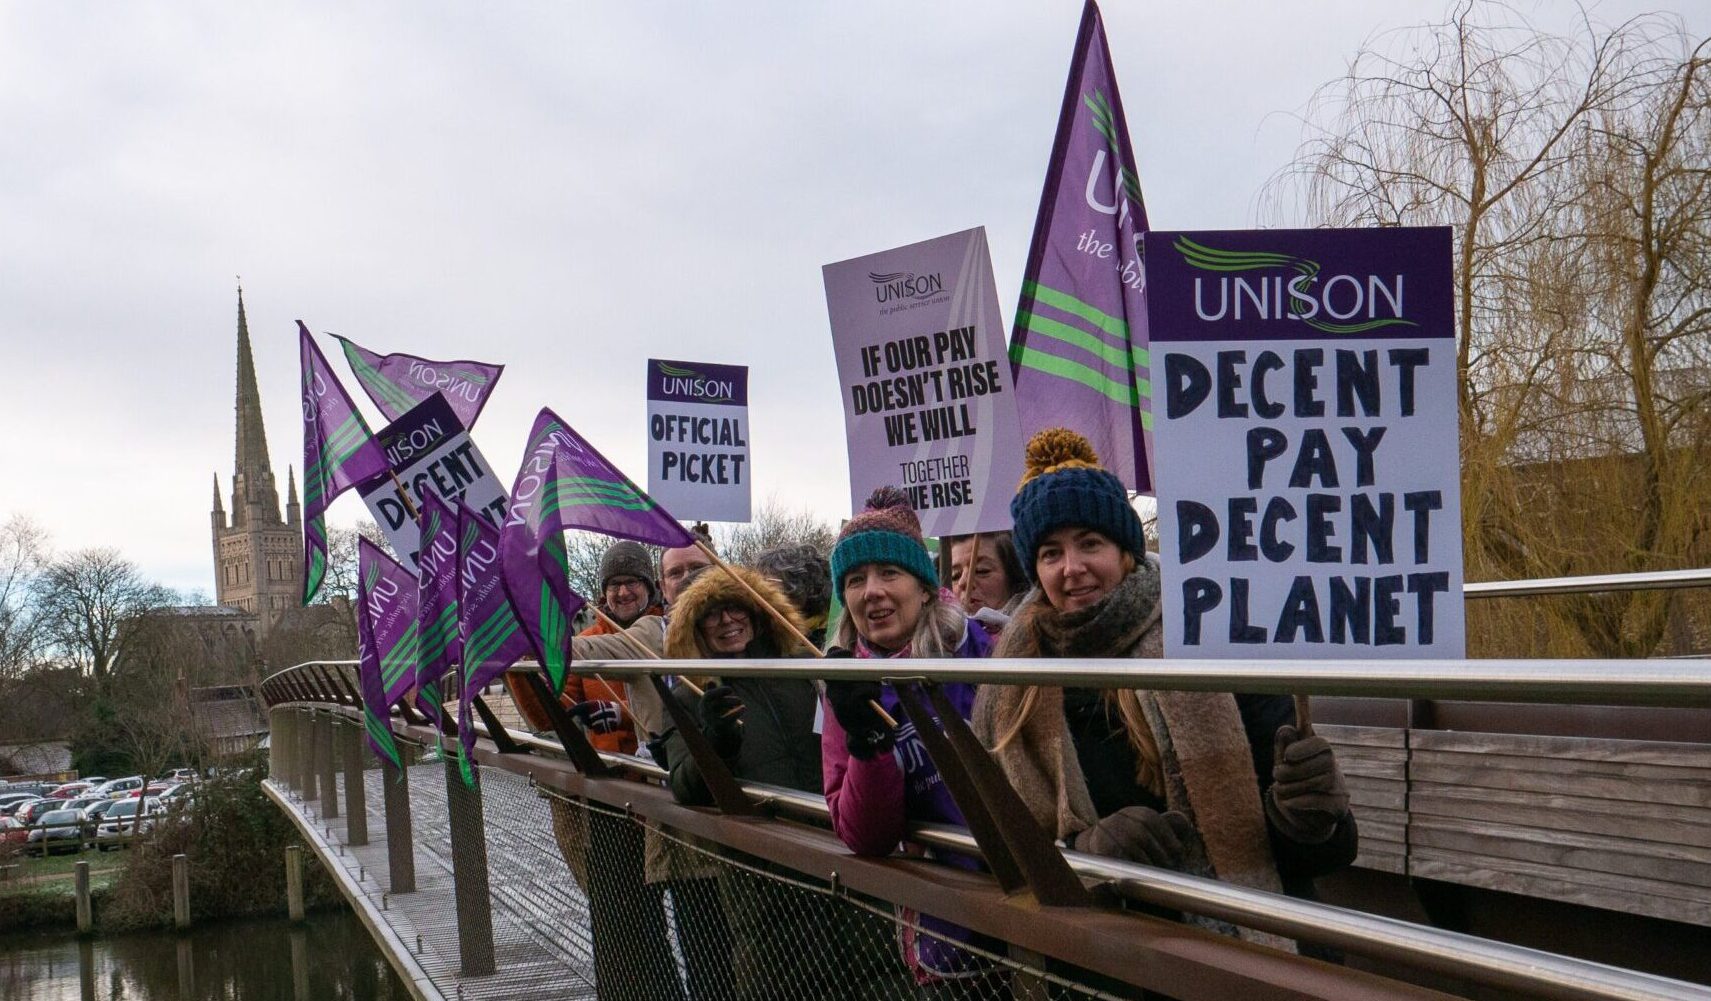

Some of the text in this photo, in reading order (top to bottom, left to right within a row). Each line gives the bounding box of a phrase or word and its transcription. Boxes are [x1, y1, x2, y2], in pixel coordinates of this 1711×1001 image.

[1077, 230, 1113, 259] the
[876, 273, 942, 303] UNISON
[1194, 274, 1403, 321] UNISON
[861, 326, 976, 377] IF OUR PAY
[662, 376, 732, 399] UNISON
[851, 360, 1002, 416] DOESN'T RISE
[1164, 347, 1430, 419] DECENT
[385, 417, 444, 468] NISON
[651, 413, 747, 447] OFFICIAL
[884, 404, 976, 447] WE WILL
[662, 451, 745, 485] PICKET
[900, 454, 970, 485] TOGETHER
[1246, 426, 1388, 490] PAY
[931, 480, 974, 508] RISE
[1176, 490, 1443, 565] DECENT
[1182, 571, 1450, 646] PLANET
